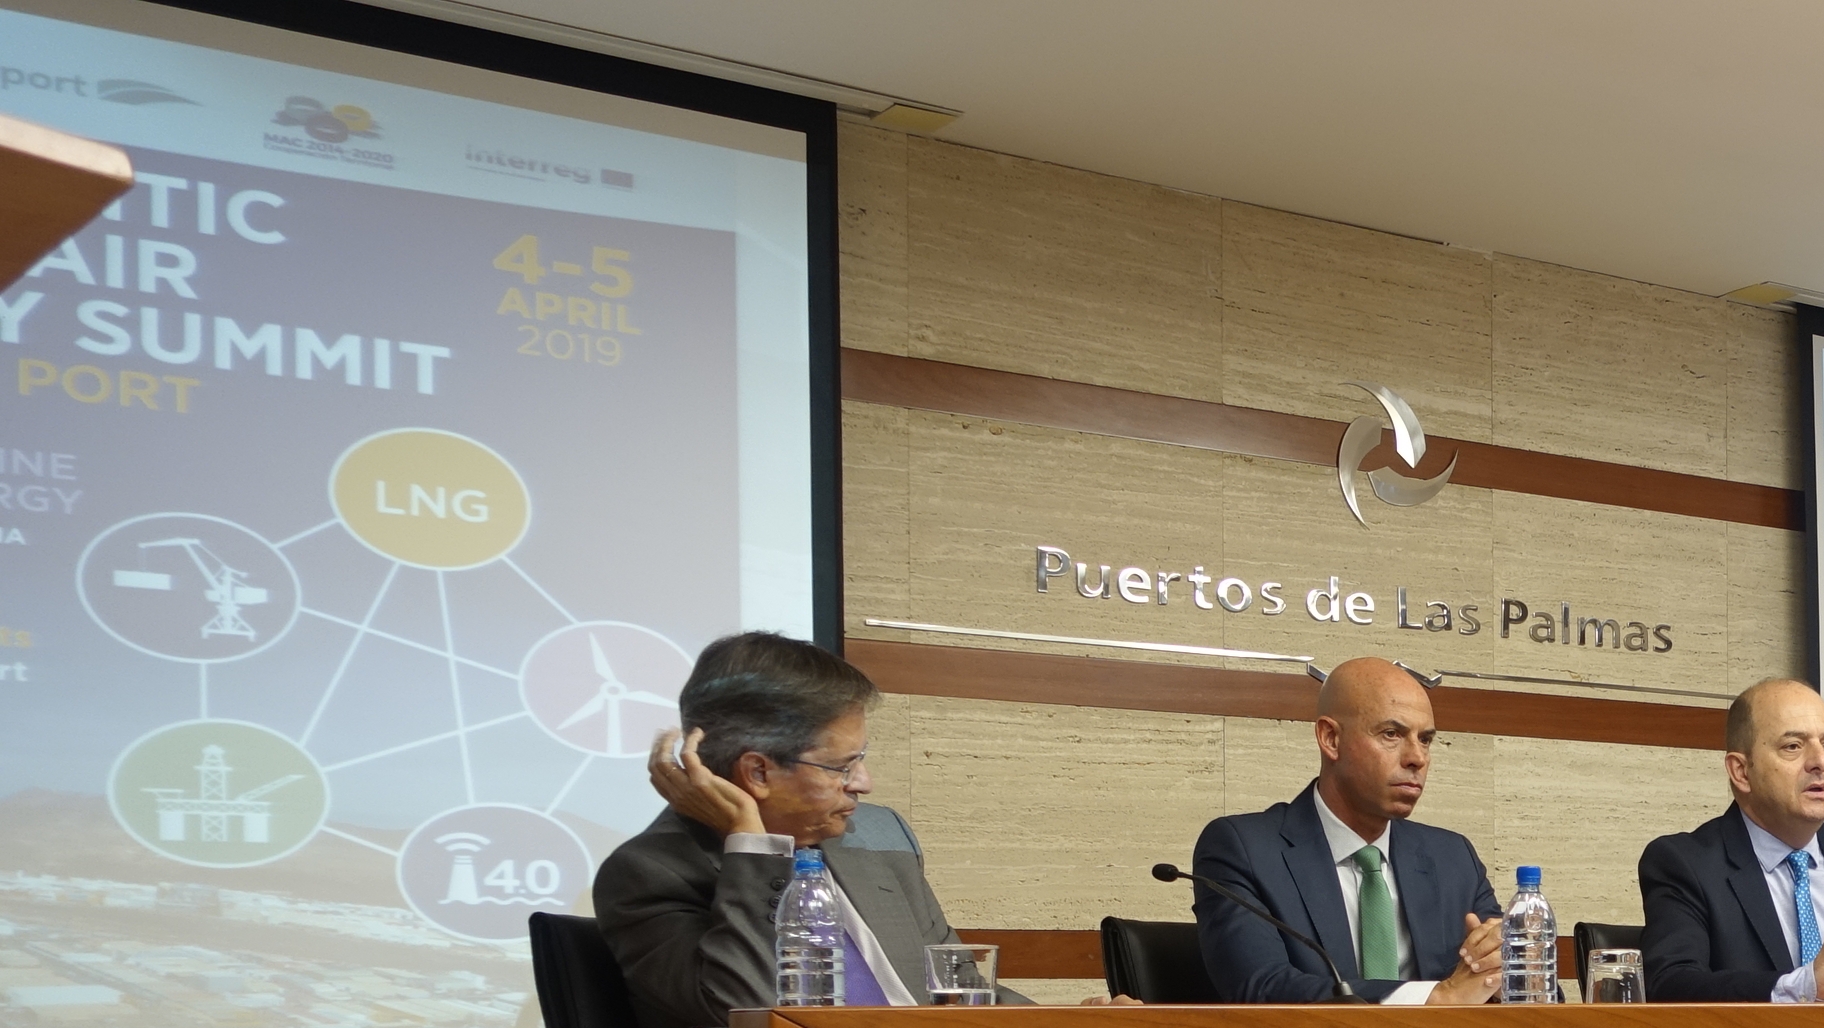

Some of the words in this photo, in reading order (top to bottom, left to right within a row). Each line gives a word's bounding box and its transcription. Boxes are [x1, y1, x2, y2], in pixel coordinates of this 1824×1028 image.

[263, 132, 303, 148] MAC
[102, 171, 286, 244] TIC
[493, 234, 633, 298] 4-5
[496, 287, 642, 335] APRIL
[74, 300, 451, 394] SUMMIT
[517, 325, 623, 367] 2019
[18, 357, 203, 413] PORT
[376, 480, 489, 523] LNG
[1036, 545, 1286, 617] Puertos
[1306, 576, 1375, 624] de
[1397, 586, 1480, 636] Las
[1500, 597, 1673, 654] Palmas
[483, 858, 561, 896] 4.0
